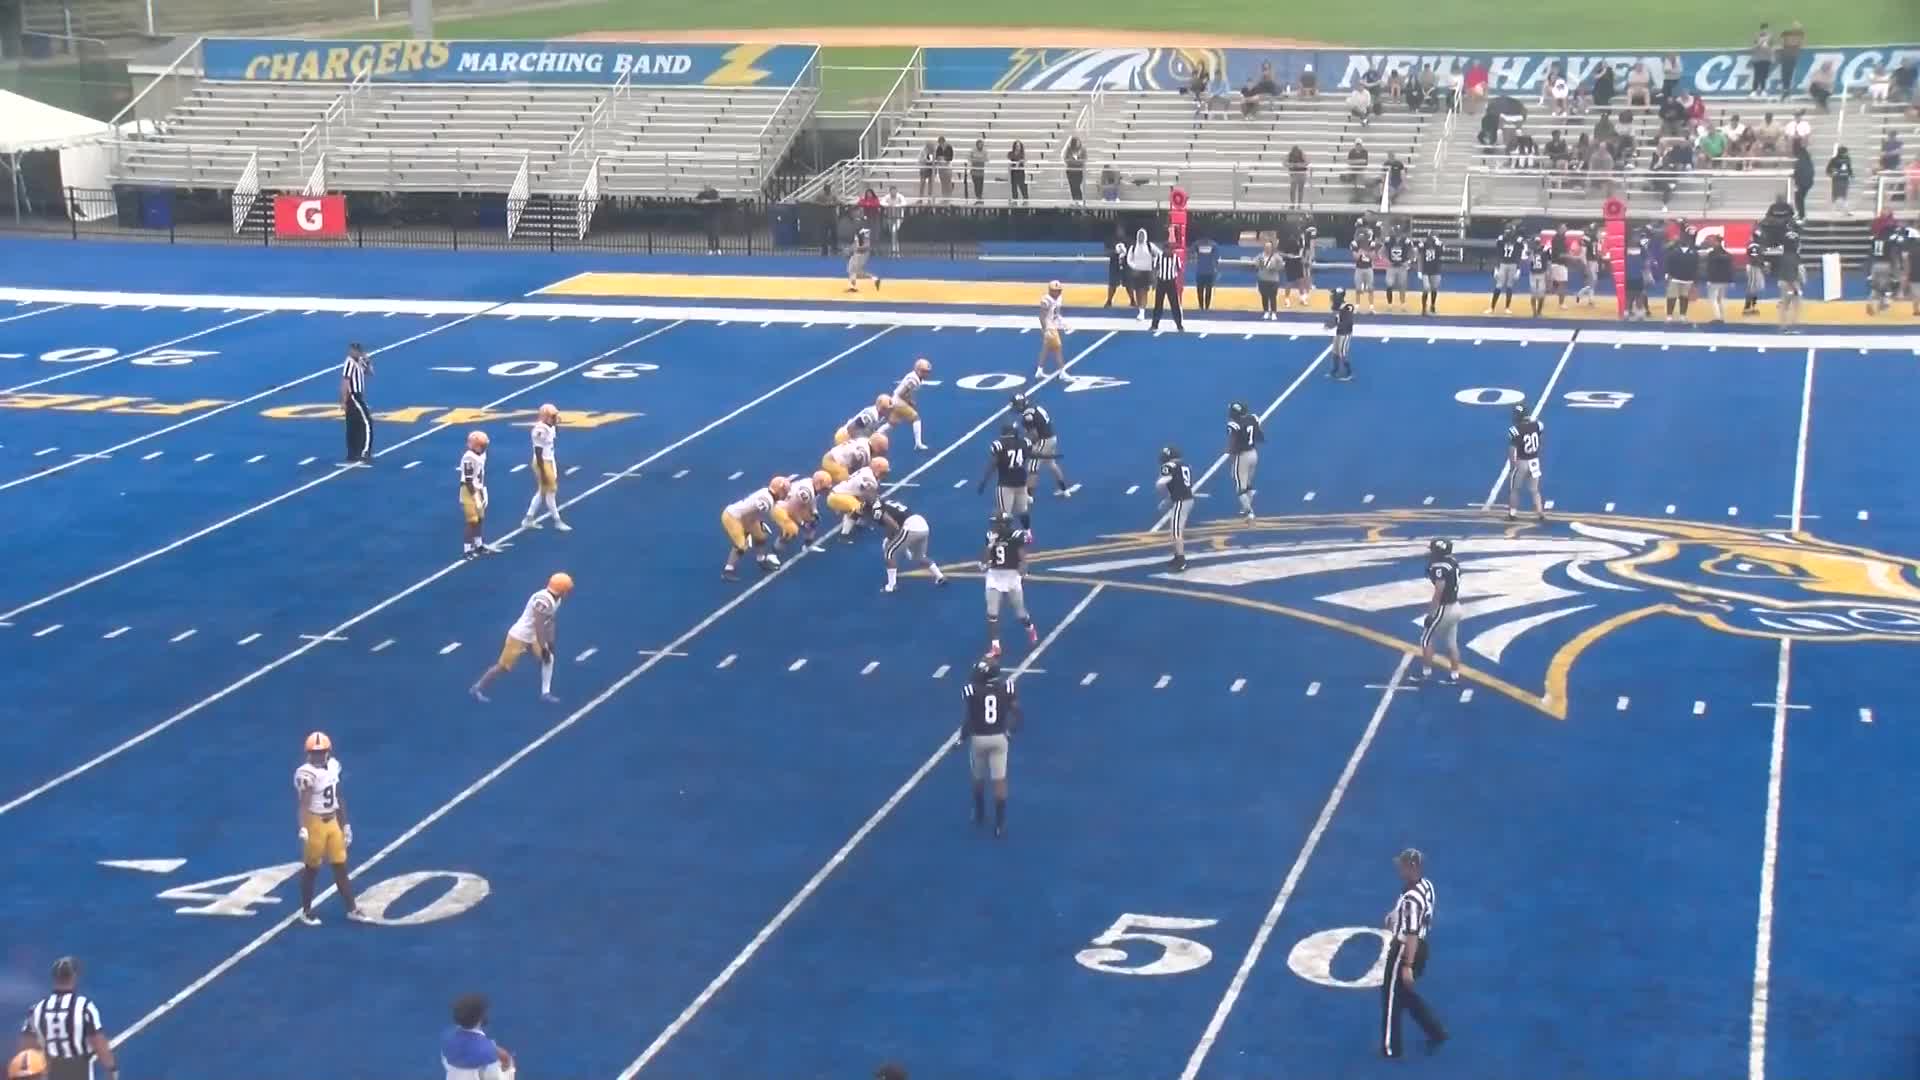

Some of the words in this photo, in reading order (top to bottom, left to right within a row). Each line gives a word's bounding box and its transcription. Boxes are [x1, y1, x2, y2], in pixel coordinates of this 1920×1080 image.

[245, 39, 450, 80] CHARGERS
[457, 52, 603, 72] MARCHING
[613, 53, 691, 73] BAND
[296, 200, 323, 231] G
[1246, 425, 1254, 446] 7
[1523, 432, 1539, 454] 20
[1007, 448, 1024, 468] 74
[1181, 465, 1191, 487] 9
[996, 545, 1006, 565] 9
[984, 695, 997, 724] 8
[323, 784, 334, 809] 9
[155, 861, 490, 925] 40
[1075, 912, 1394, 988] 50
[45, 1012, 68, 1040] H
